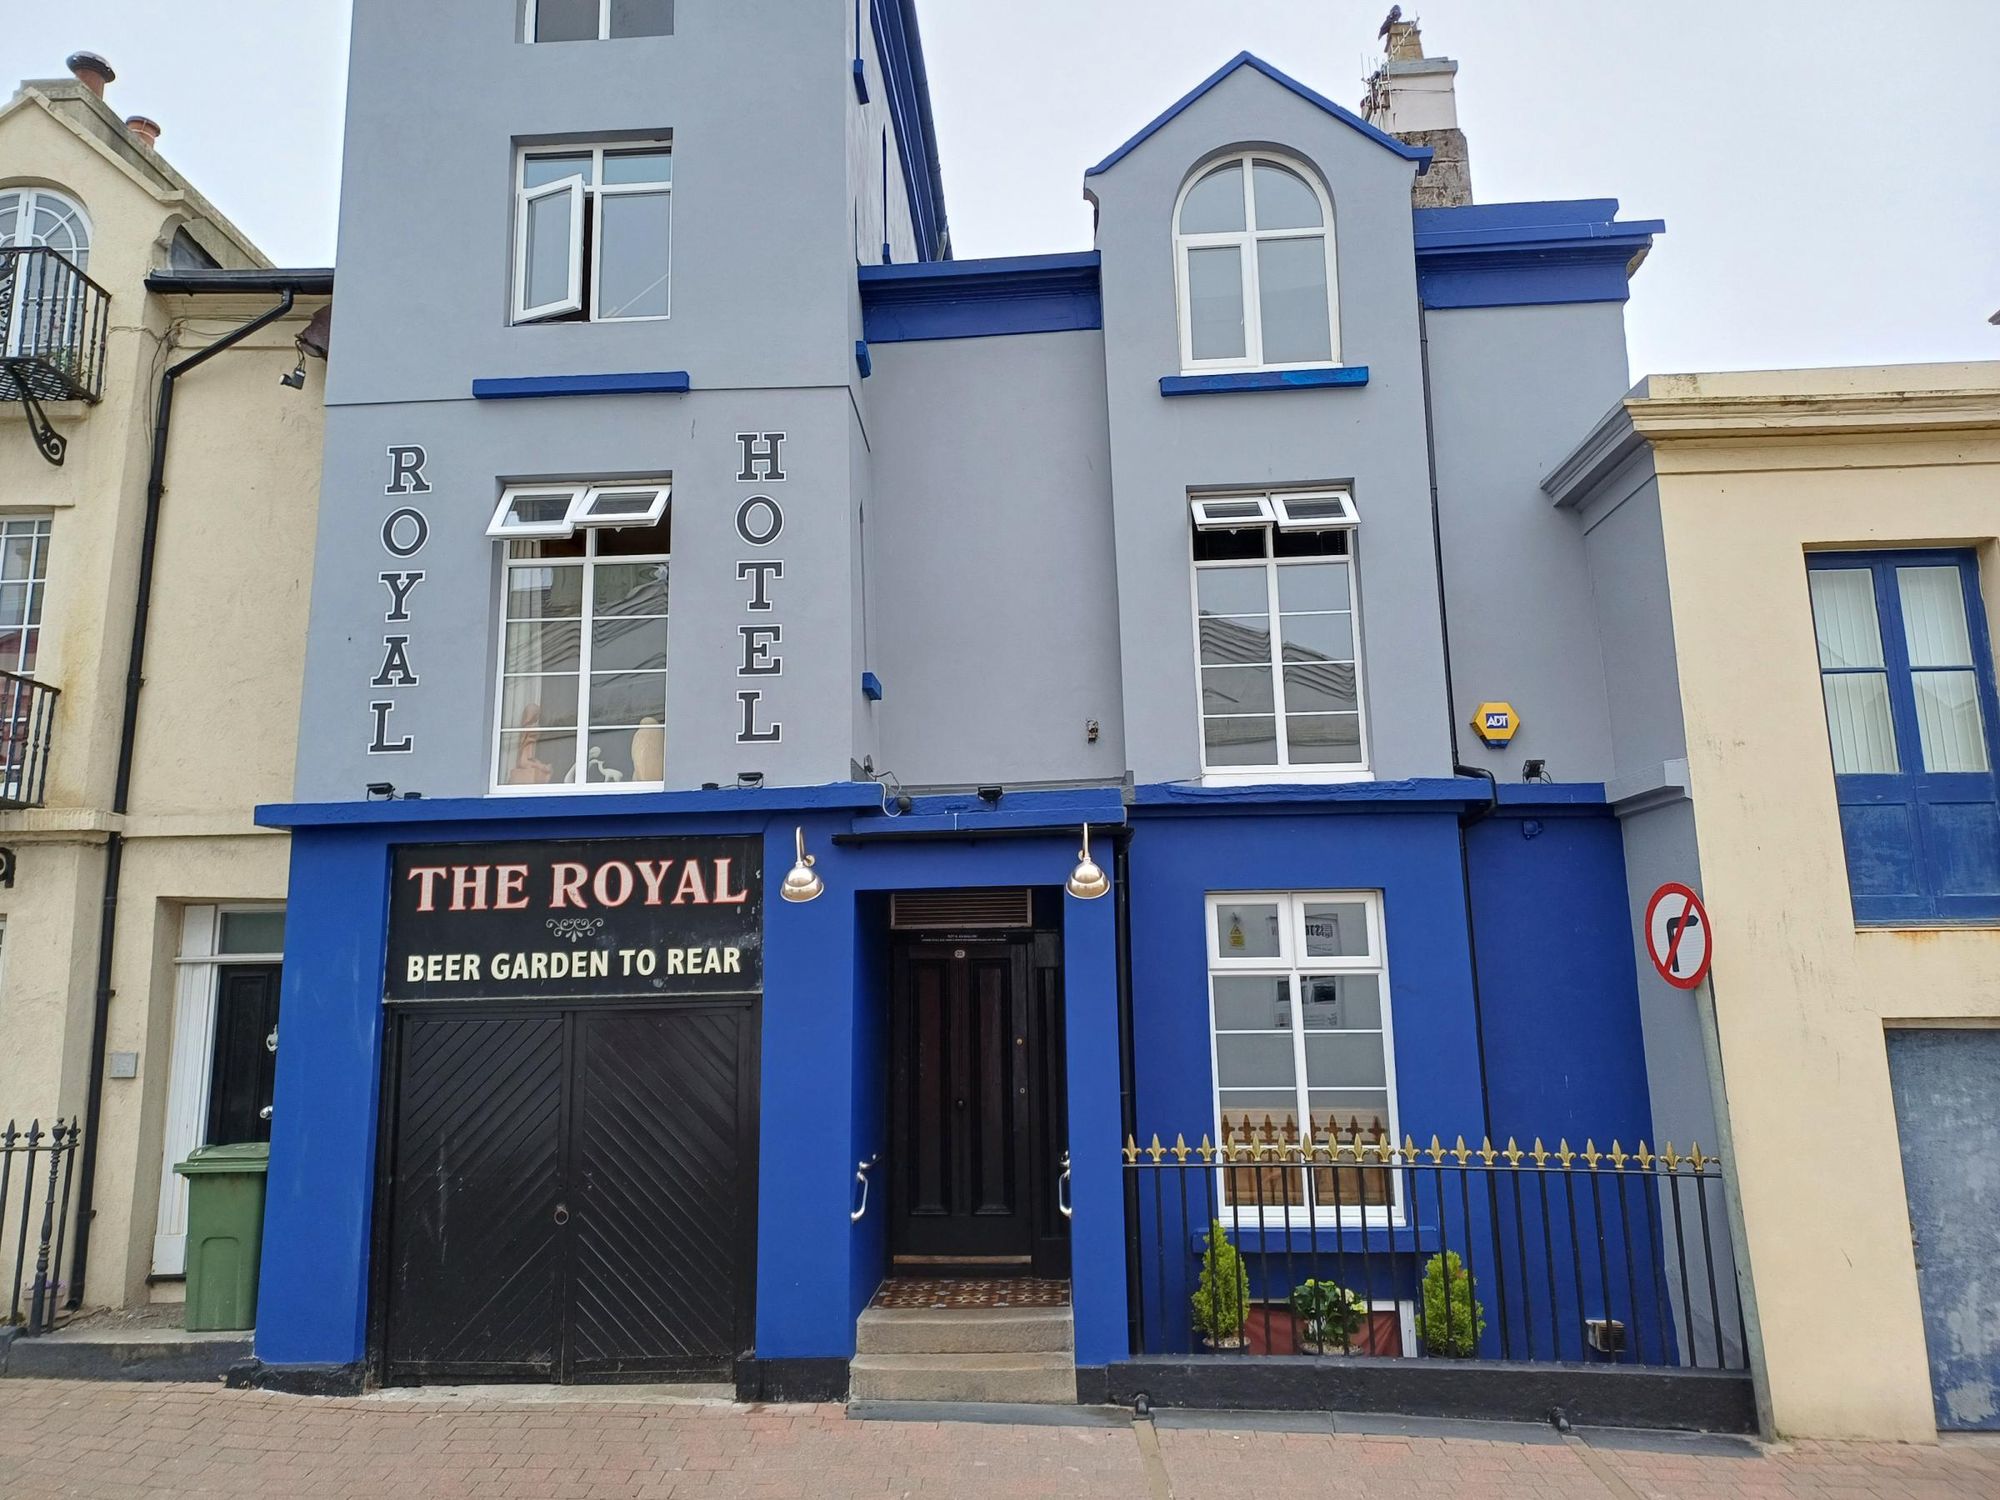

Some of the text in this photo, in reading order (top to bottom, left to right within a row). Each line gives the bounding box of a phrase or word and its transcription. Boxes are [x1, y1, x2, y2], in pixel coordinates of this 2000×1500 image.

[367, 444, 432, 754] ROYAL
[735, 432, 788, 744] HOTEL
[1486, 715, 1508, 727] ADT
[407, 857, 748, 912] THE ROYAL
[406, 946, 742, 983] BEER GARDEN TO REAR
